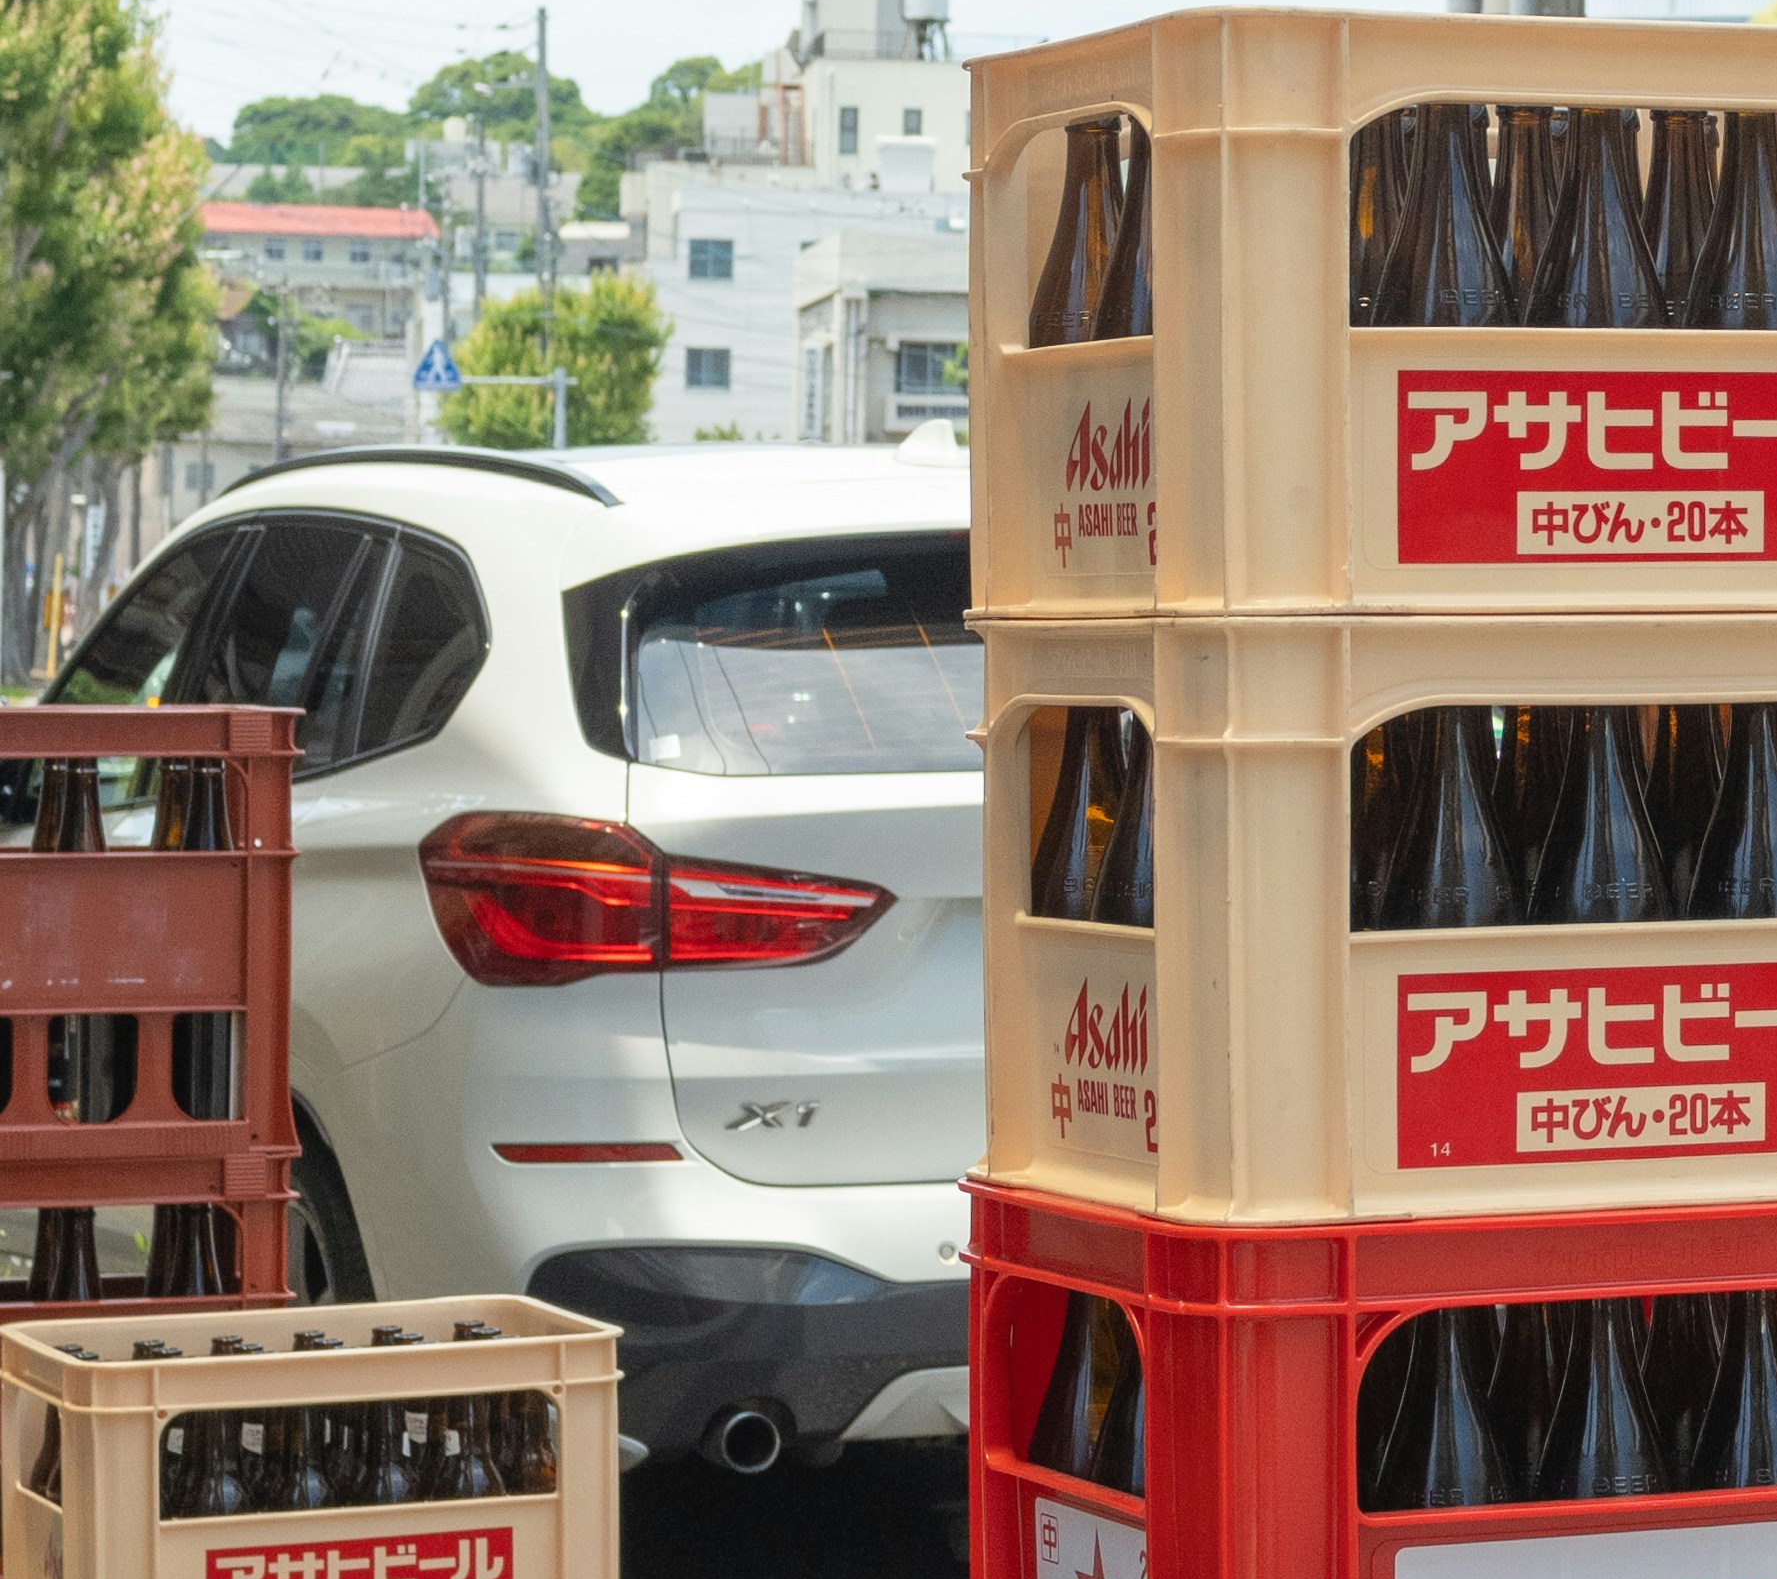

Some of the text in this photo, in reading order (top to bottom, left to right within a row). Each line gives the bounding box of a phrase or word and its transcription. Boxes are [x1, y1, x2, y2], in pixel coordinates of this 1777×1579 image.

[1065, 396, 1151, 492] Asahi
[1054, 502, 1073, 569] 中
[1078, 502, 1138, 537] ASAHI BEER
[1531, 500, 1749, 547] 中びん・20本
[1064, 976, 1149, 1077] Asahi
[724, 1100, 819, 1131] X1
[1051, 1073, 1073, 1140] 中
[1077, 1078, 1138, 1120] ASAHI BEER
[1530, 1089, 1752, 1144] 中びん・20本
[1429, 1141, 1452, 1158] 14
